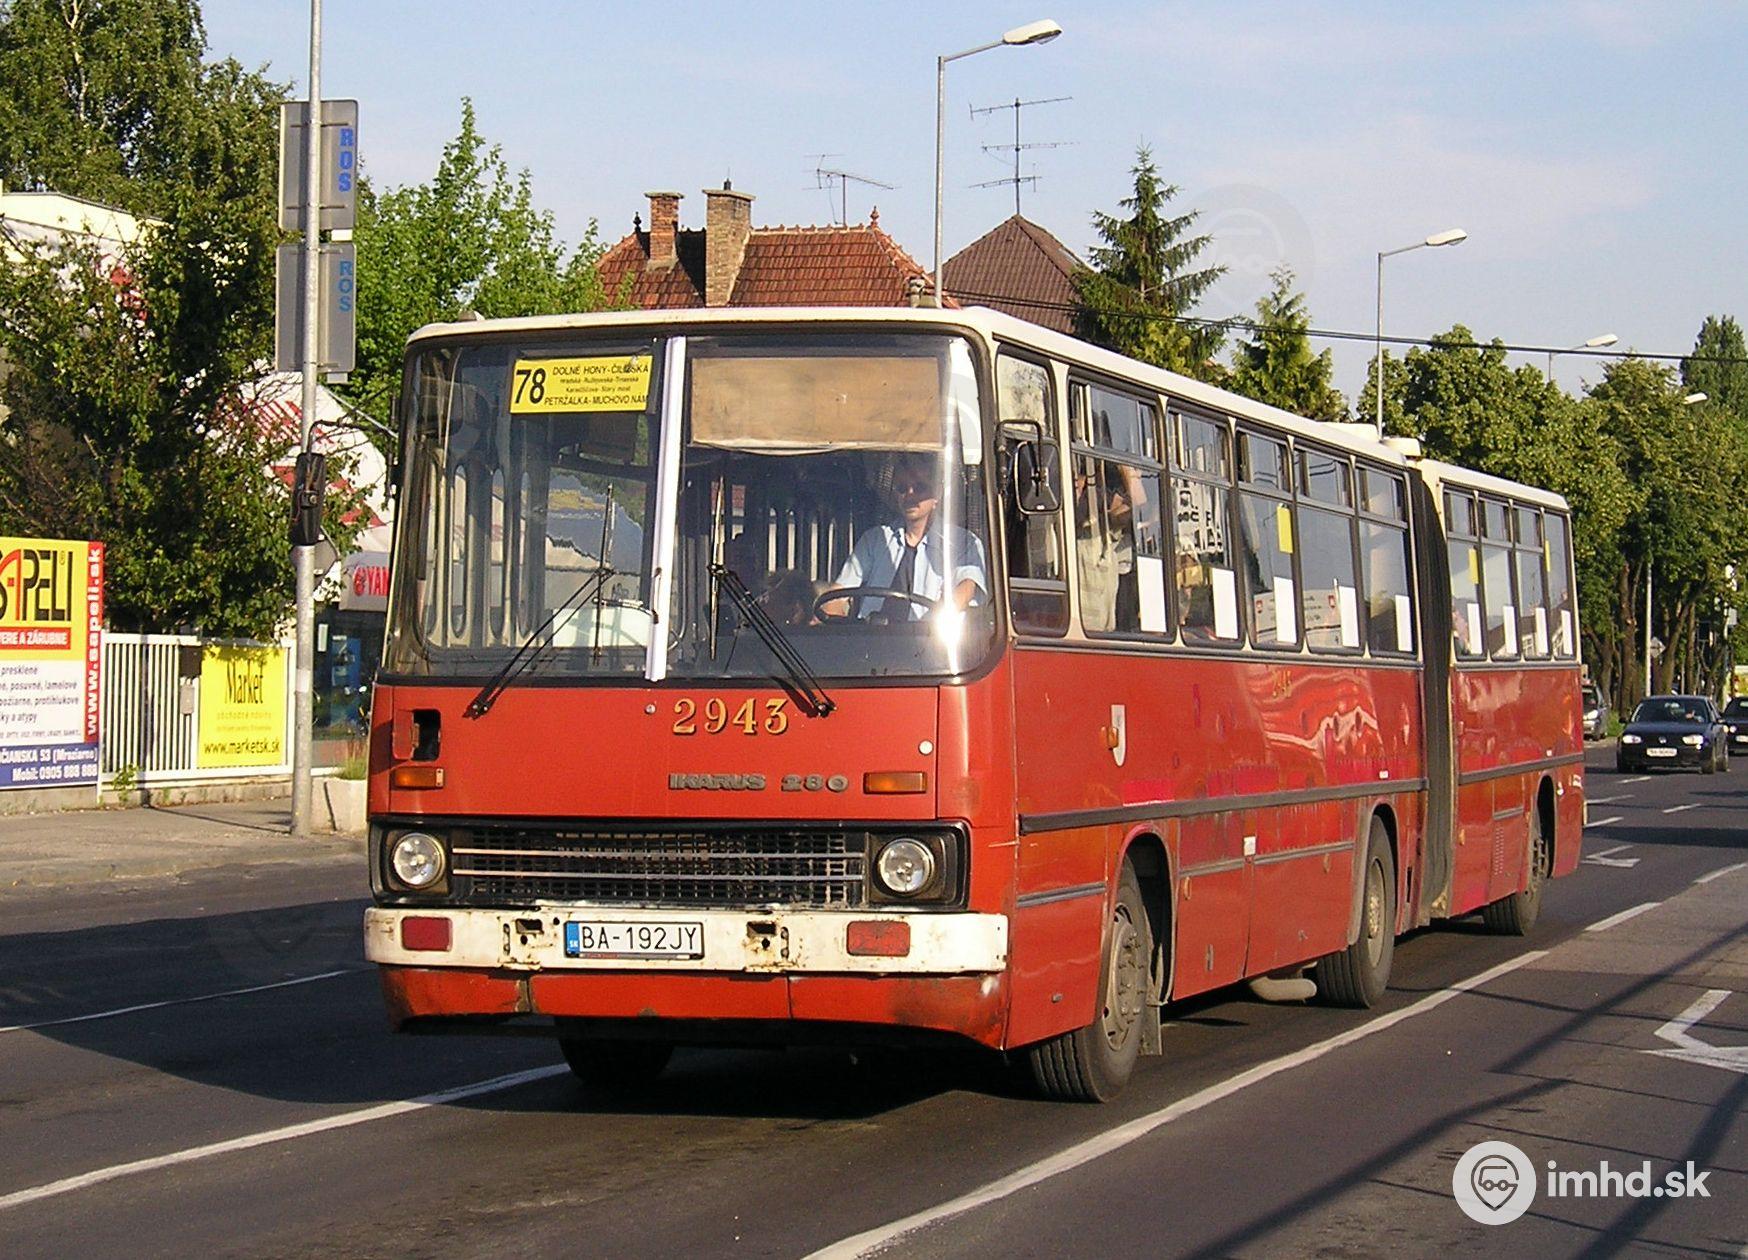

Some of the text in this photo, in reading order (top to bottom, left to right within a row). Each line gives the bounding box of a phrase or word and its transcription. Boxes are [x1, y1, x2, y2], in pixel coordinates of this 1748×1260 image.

[338, 260, 354, 312] ROS
[515, 367, 547, 405] 78
[86, 548, 101, 735] www.sapeli.sk
[225, 657, 264, 704] Market
[672, 698, 789, 735] 2943
[668, 772, 849, 792] IKARUS 280
[581, 925, 698, 951] BA-192JY
